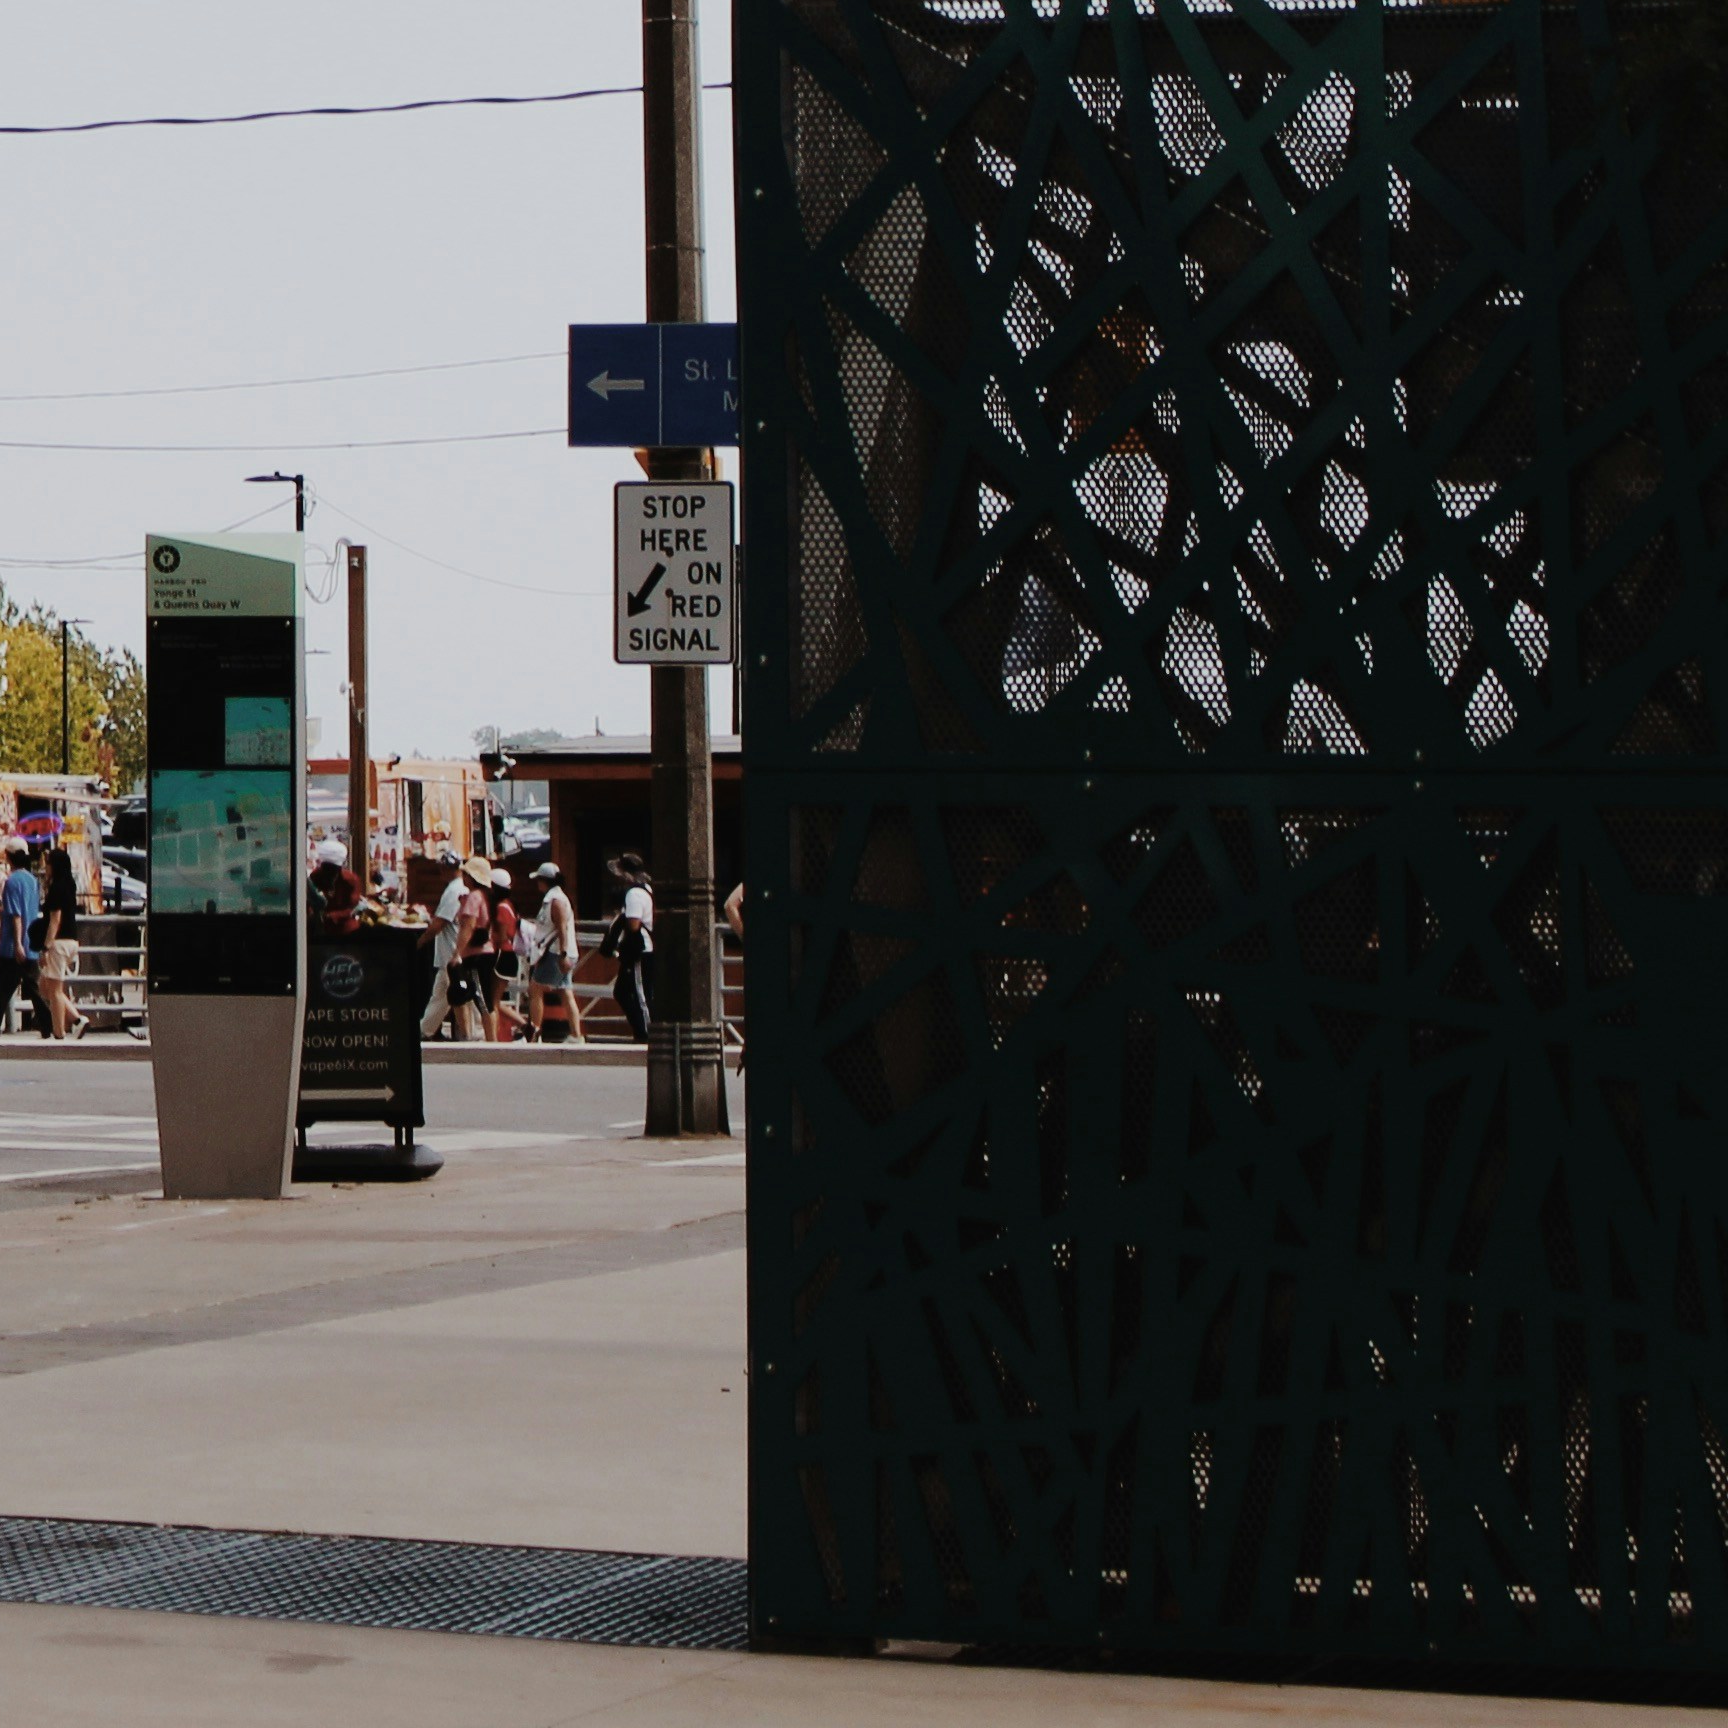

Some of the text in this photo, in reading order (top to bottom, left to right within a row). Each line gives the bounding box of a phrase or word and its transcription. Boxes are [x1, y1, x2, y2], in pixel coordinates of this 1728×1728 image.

[685, 359, 717, 382] St.
[642, 495, 706, 519] STOP
[640, 528, 708, 552] HERE
[687, 561, 722, 586] ON
[153, 588, 197, 599] Yonge St
[163, 600, 199, 610] Queens
[202, 599, 227, 611] Quay
[230, 599, 241, 610] W
[670, 594, 722, 618] RED
[628, 627, 720, 652] SIGNAL
[307, 1008, 390, 1022] APE STORE
[303, 1034, 389, 1048] NOW OPEN!
